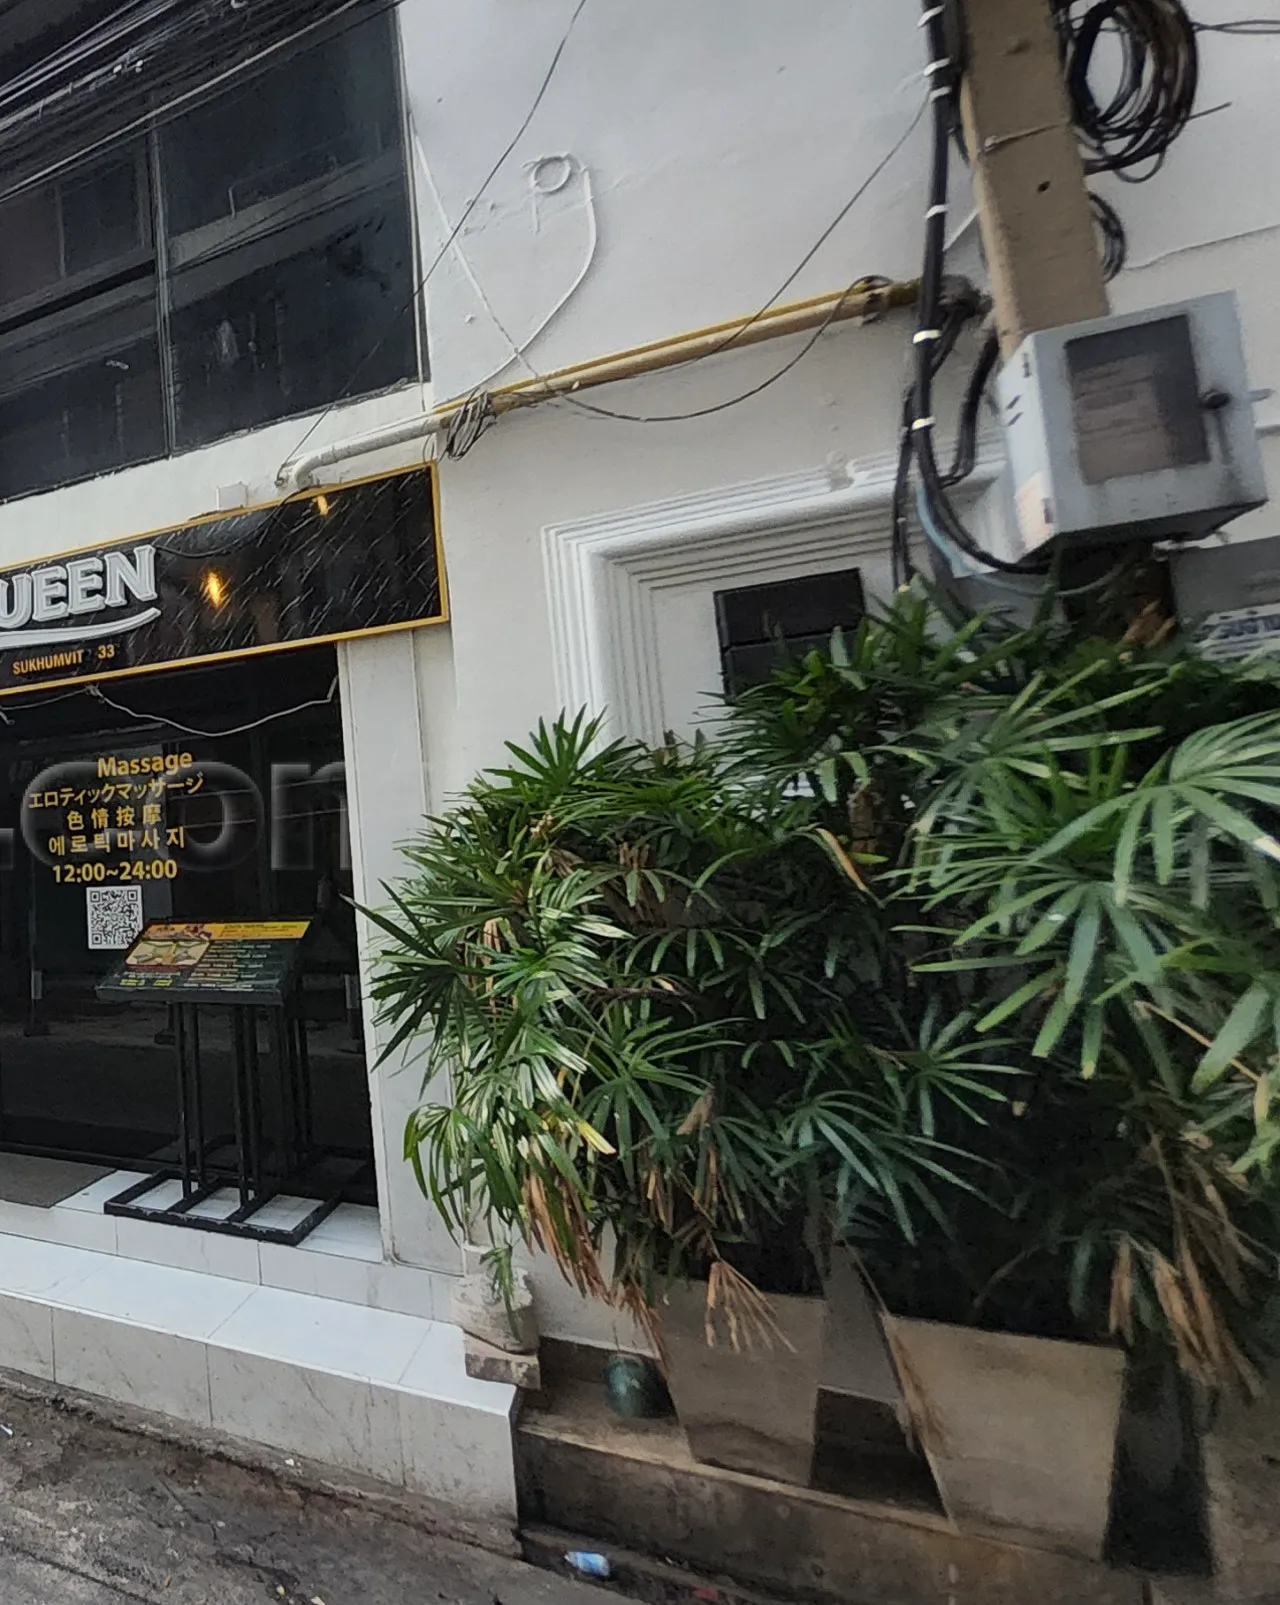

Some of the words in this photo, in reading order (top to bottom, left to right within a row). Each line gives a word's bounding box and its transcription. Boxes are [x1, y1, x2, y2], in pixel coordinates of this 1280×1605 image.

[12, 649, 84, 675] SUKHUMVIT
[97, 644, 116, 660] 33
[97, 752, 193, 778] Massage
[52, 859, 178, 883] 12:00~24:00
